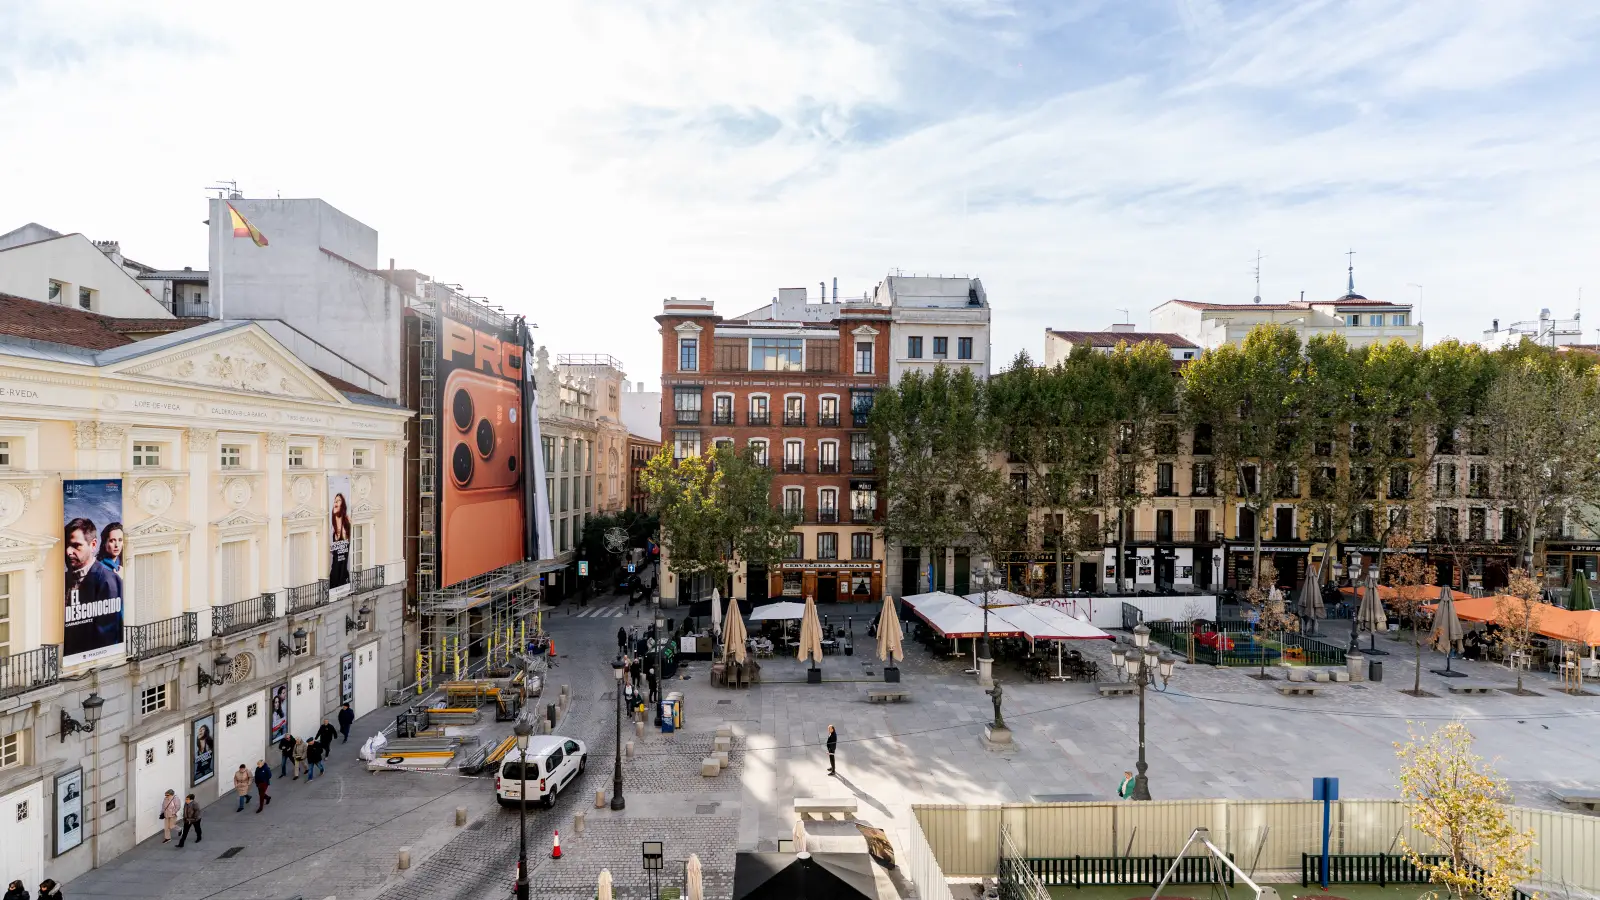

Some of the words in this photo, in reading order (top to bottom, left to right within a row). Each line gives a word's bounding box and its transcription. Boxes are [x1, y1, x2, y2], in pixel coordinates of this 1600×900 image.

[442, 316, 524, 380] PRO
[65, 597, 122, 623] DESCONOCIDO
[70, 589, 81, 606] EL
